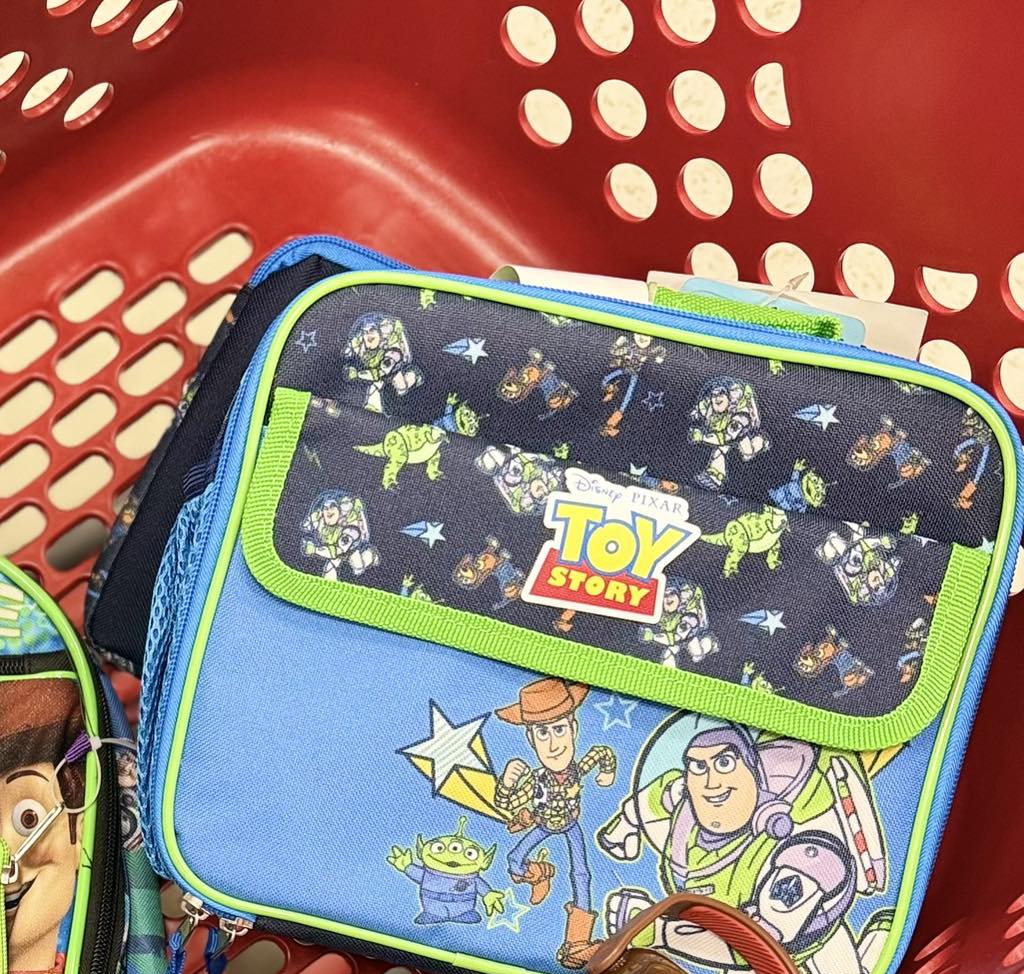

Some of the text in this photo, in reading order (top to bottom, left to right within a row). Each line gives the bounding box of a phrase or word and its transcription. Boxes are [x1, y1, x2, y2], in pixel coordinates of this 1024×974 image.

[632, 493, 682, 515] PIXAR
[552, 500, 693, 582] TOY
[548, 567, 650, 607] STORY
